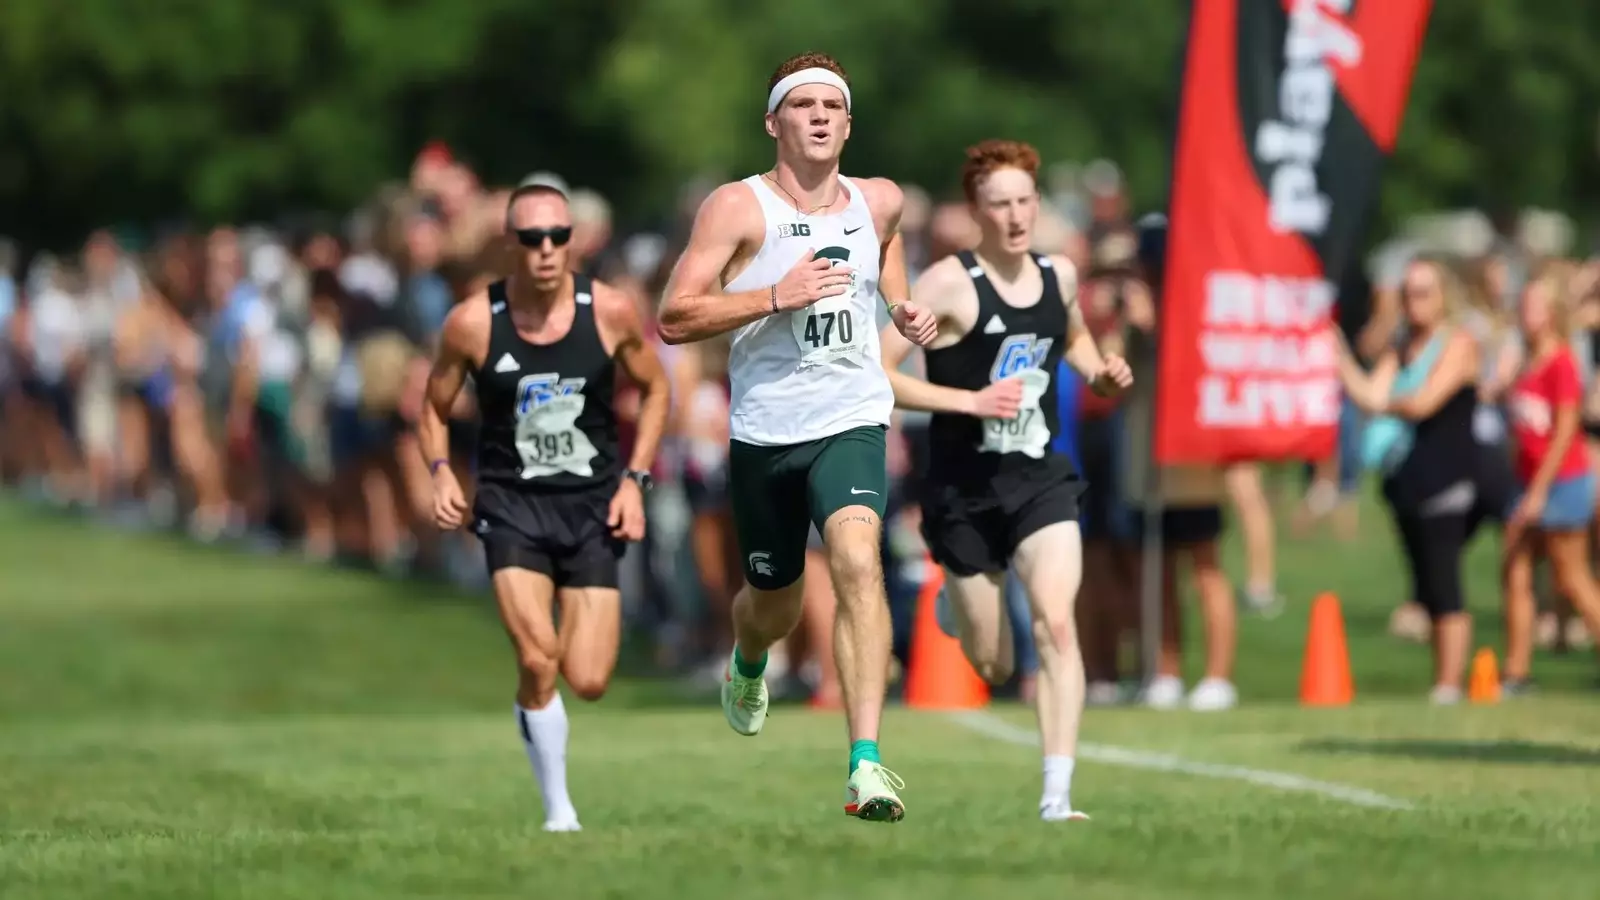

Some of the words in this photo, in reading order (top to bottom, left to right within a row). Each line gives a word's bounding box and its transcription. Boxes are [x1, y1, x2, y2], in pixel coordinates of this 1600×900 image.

[804, 309, 853, 348] 470
[1197, 373, 1341, 428] LIVE
[527, 431, 574, 462] 393
